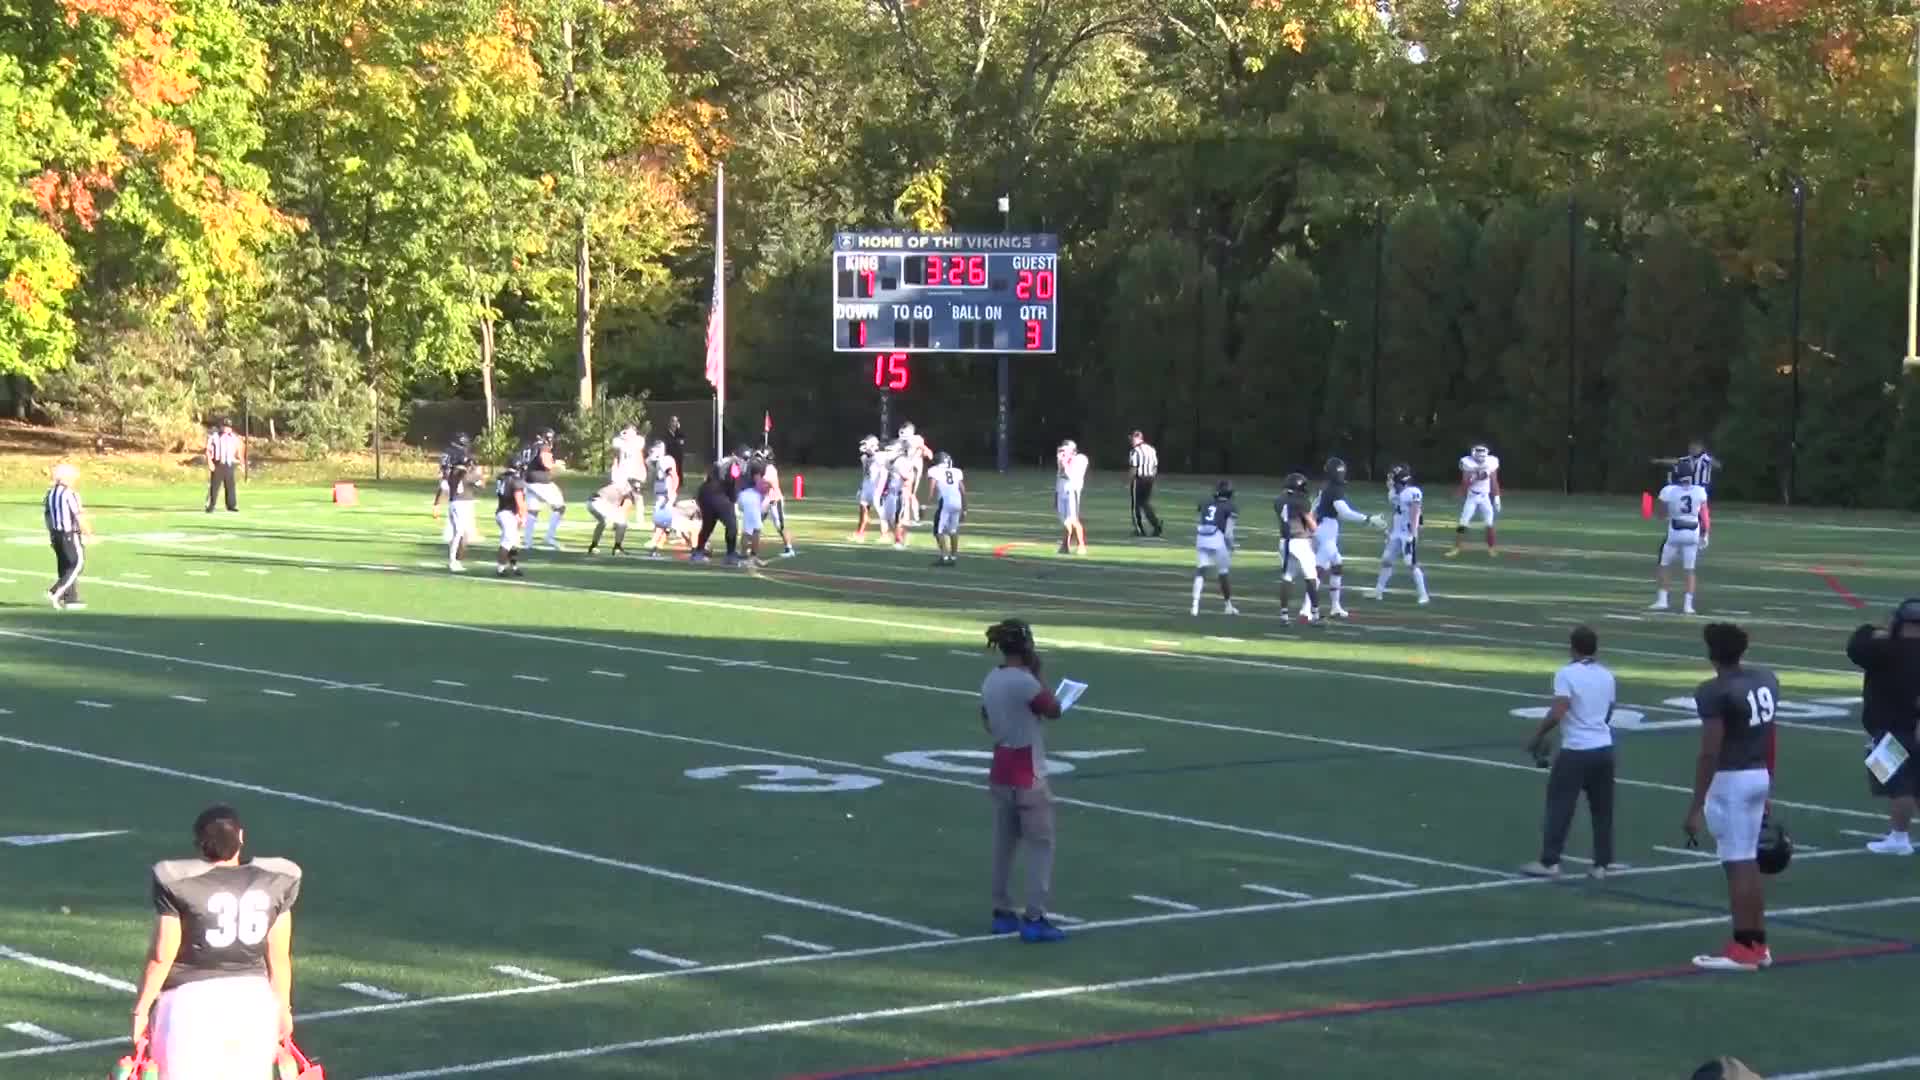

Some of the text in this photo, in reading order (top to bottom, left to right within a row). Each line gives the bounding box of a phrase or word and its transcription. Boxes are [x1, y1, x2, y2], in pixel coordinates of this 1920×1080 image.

[858, 236, 1032, 249] HOME OF THE VIKINGS
[845, 255, 879, 271] KING
[927, 256, 985, 286] 3:26
[1012, 255, 1053, 270] GUEST
[1016, 270, 1053, 299] 20
[836, 304, 879, 320] DOWN
[892, 304, 933, 320] TO GO
[952, 304, 1002, 320] BALL ON
[1020, 305, 1048, 320] QTR
[858, 320, 867, 348] 1
[1025, 320, 1042, 350] 3
[874, 352, 910, 390] 15
[945, 470, 954, 485] 8
[1204, 505, 1217, 521] 3
[1680, 495, 1692, 514] 3
[1746, 686, 1775, 727] 19
[683, 749, 1076, 793] 30
[205, 889, 271, 948] 36
